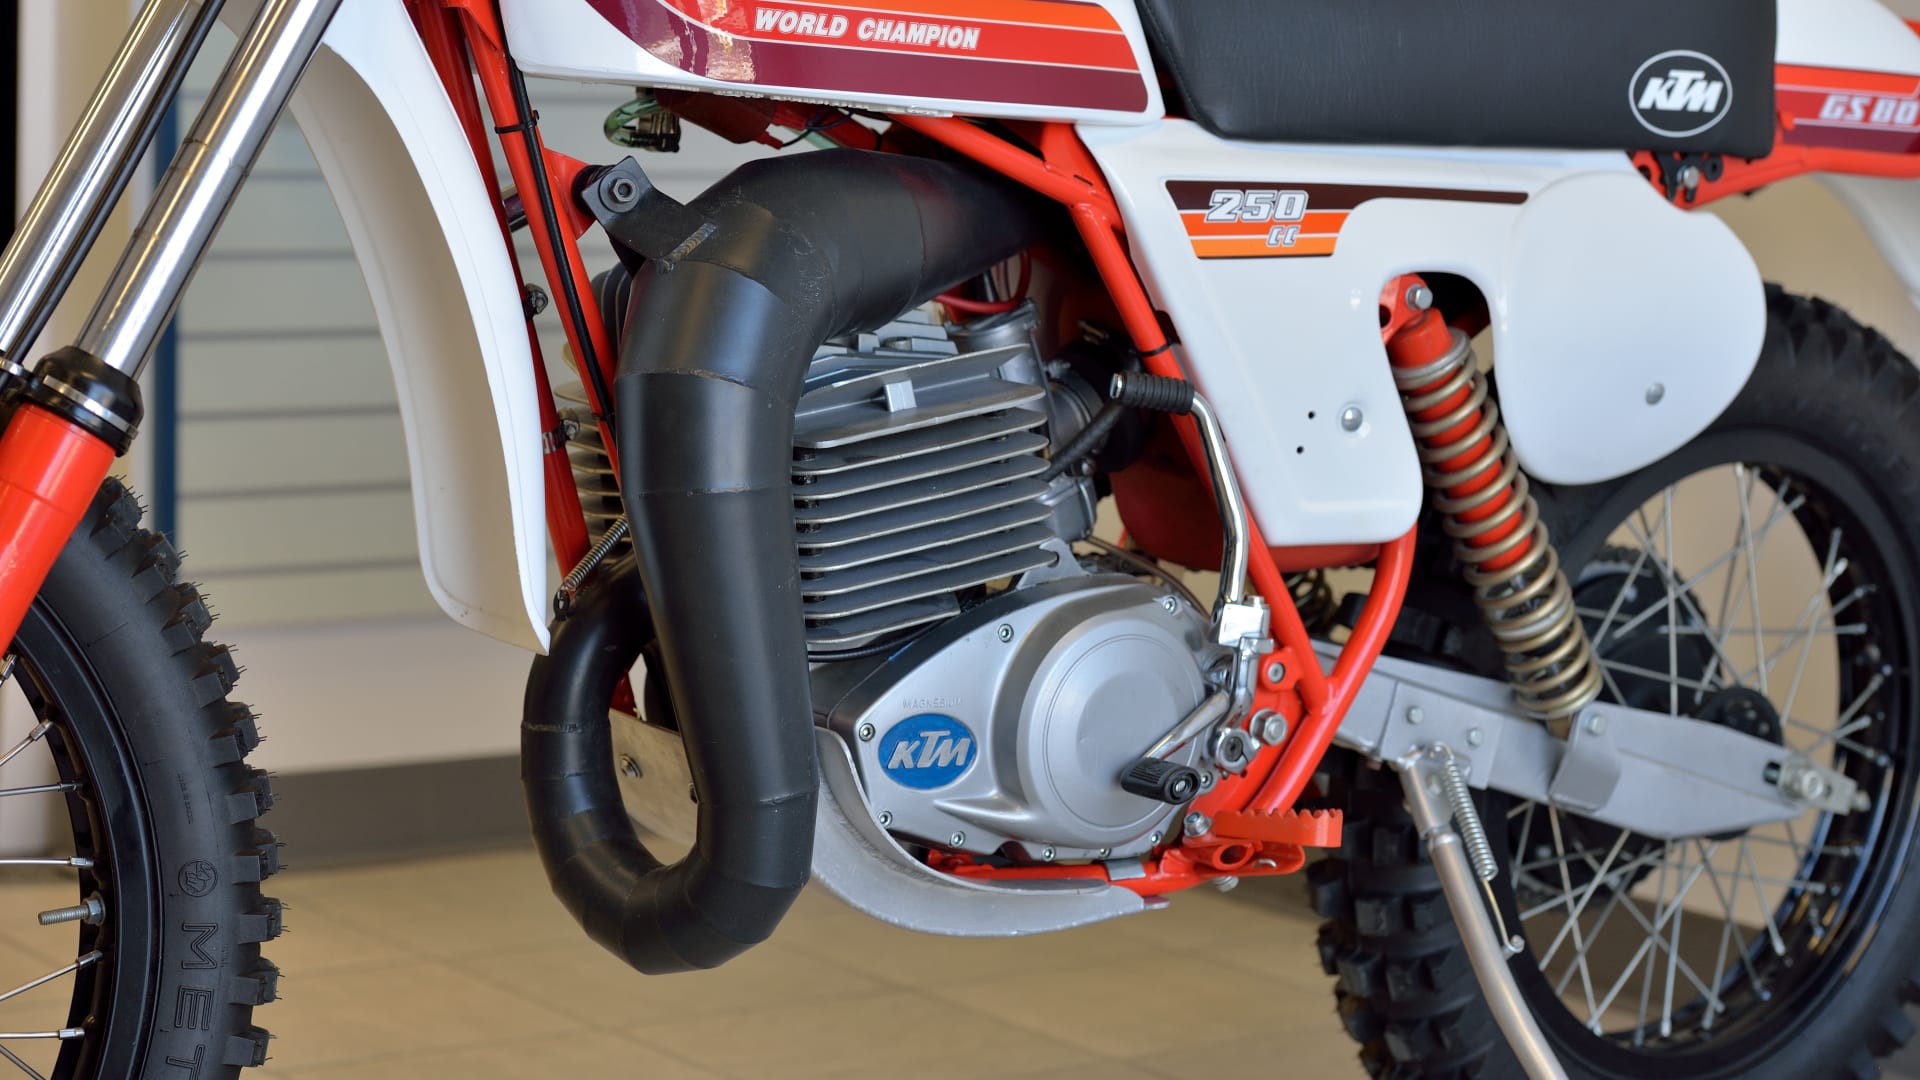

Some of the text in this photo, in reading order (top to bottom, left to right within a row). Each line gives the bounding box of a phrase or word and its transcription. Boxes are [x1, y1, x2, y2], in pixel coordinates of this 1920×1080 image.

[755, 7, 981, 50] WORLD CHAMPION
[1638, 69, 1723, 113] KTM
[1820, 94, 1871, 121] GS
[1204, 189, 1309, 223] 250
[887, 730, 971, 769] KTM
[166, 922, 218, 1080] MET
